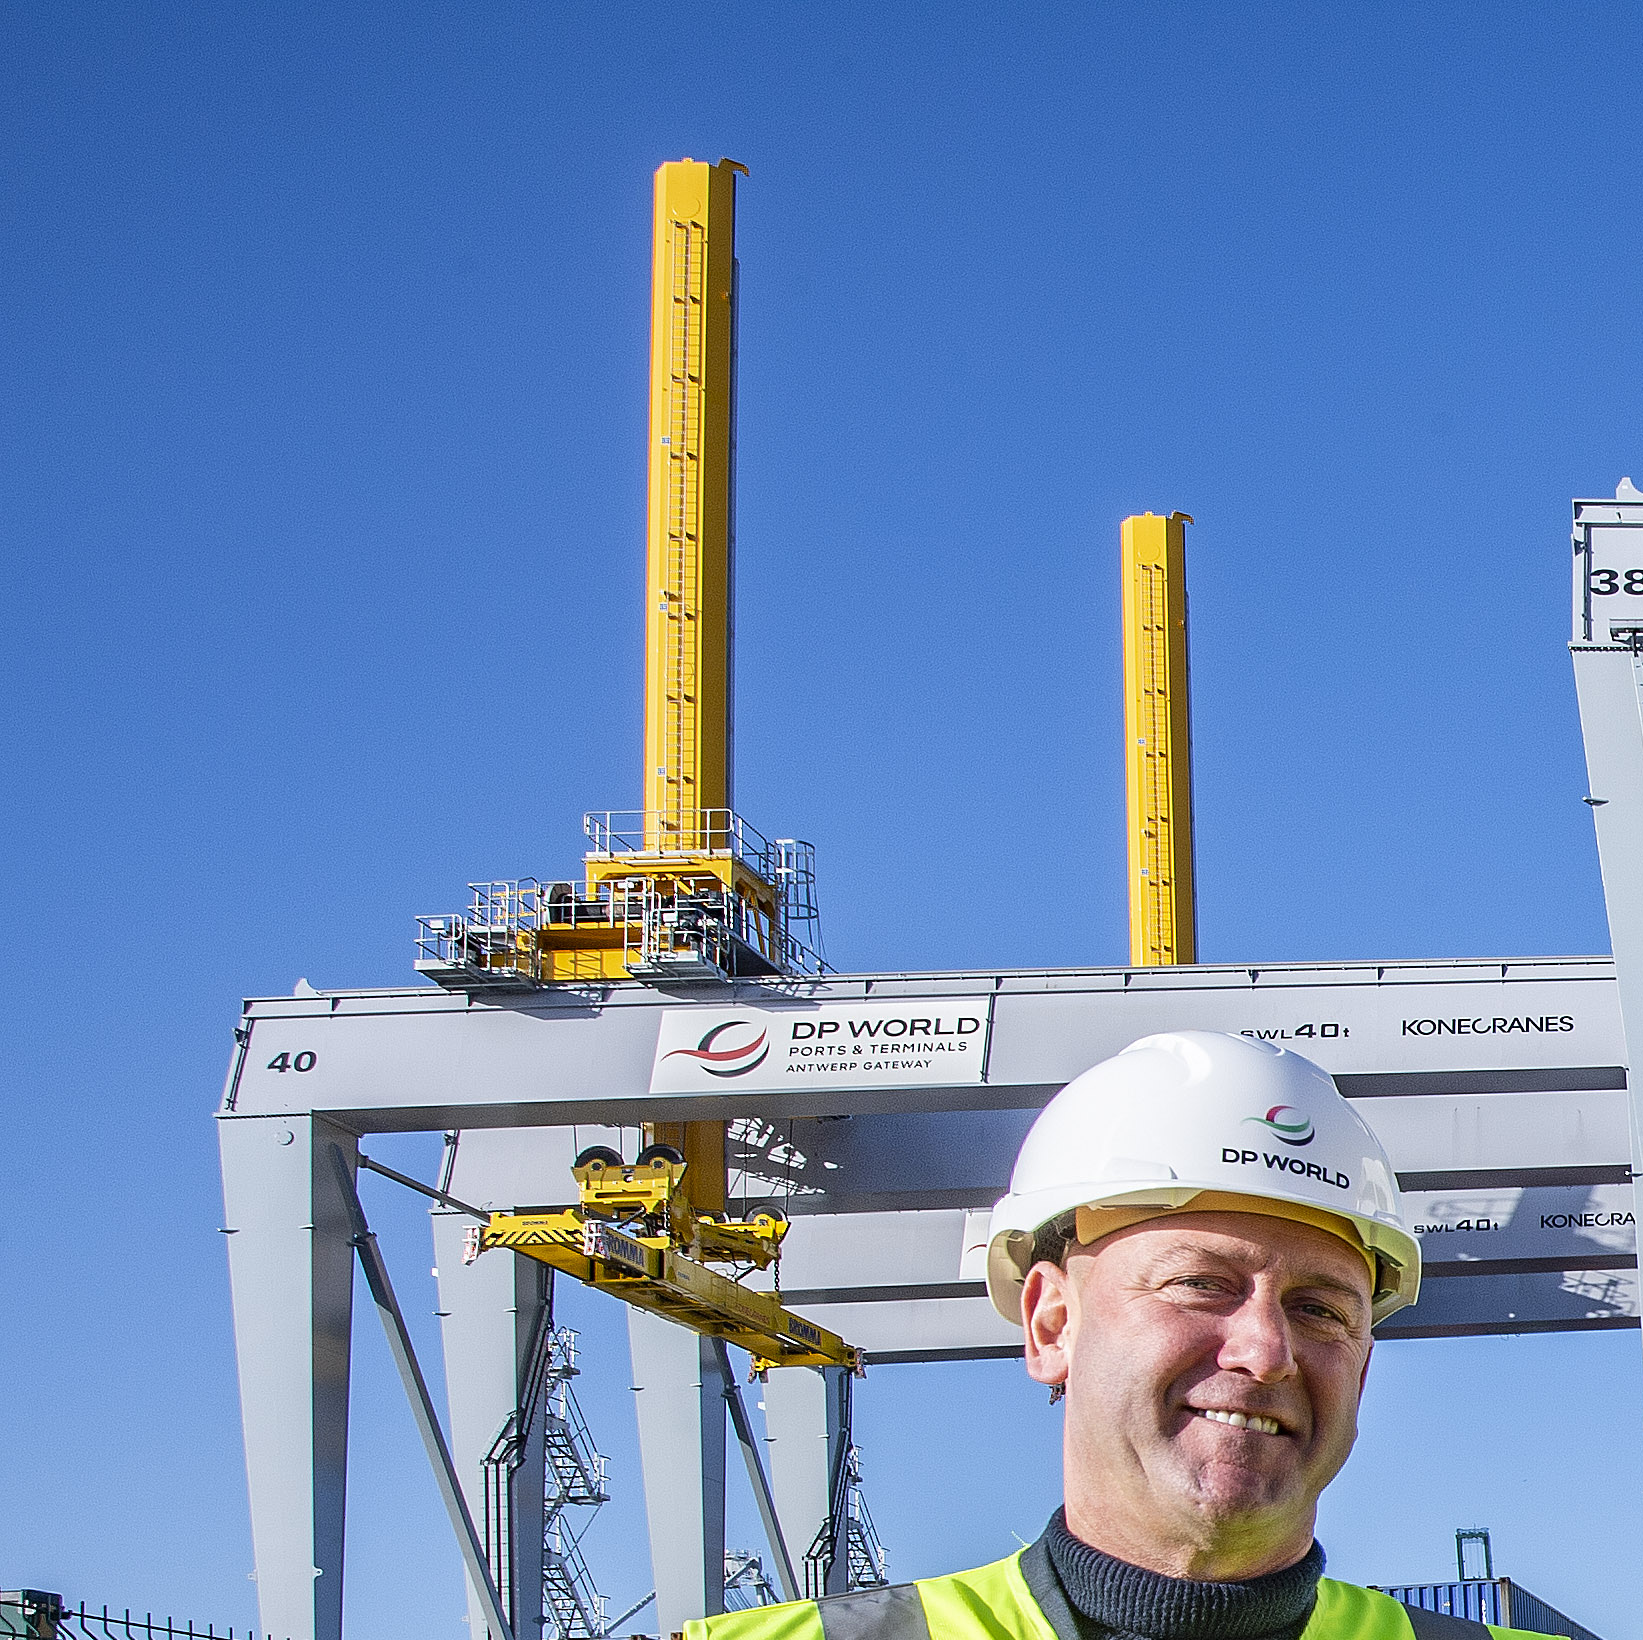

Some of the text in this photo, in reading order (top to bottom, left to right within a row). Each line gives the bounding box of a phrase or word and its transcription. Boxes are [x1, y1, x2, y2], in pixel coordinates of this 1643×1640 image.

[791, 1017, 981, 1040] DP WORLD
[1401, 1015, 1575, 1036] KONECRANES
[789, 1041, 969, 1057] PORTS & TERMINALS
[266, 1050, 317, 1074] 40
[785, 1060, 933, 1073] ANTWERP GATEWAY
[1221, 1148, 1350, 1190] DP WORLD
[1539, 1211, 1636, 1230] KONECRA
